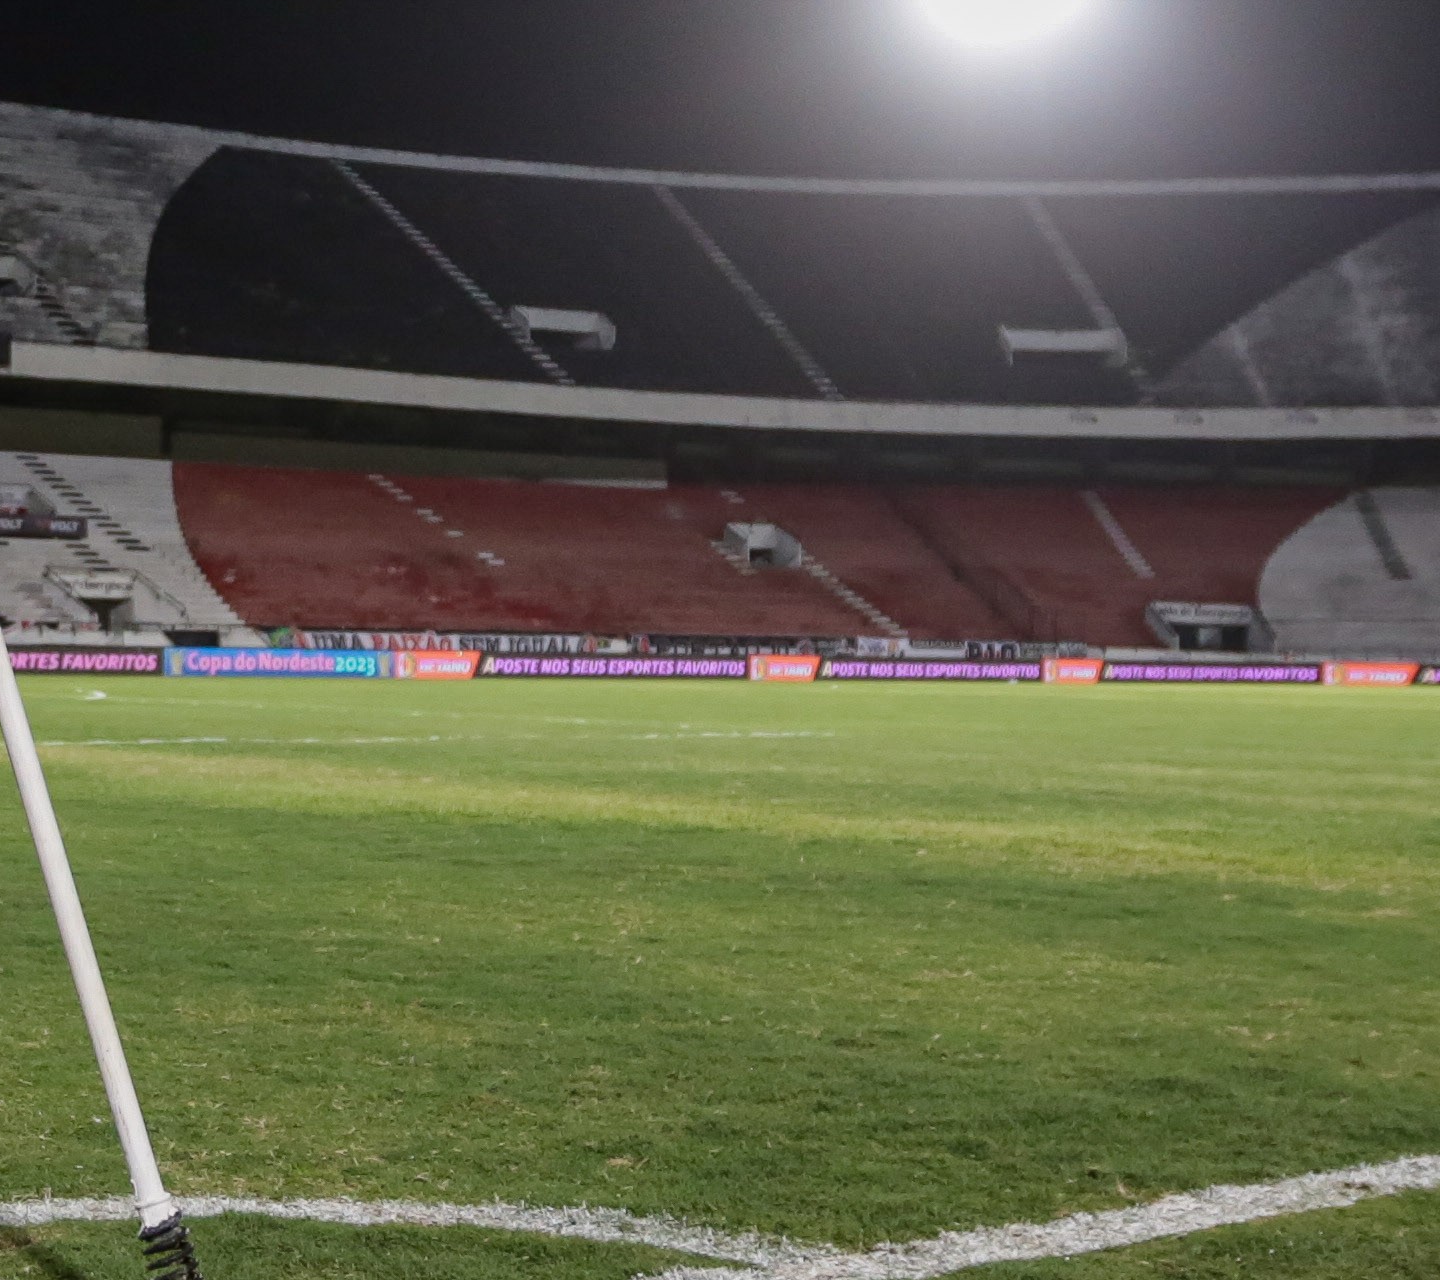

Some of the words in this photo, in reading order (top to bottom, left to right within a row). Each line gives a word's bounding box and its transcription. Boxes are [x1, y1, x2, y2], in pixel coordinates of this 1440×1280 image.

[62, 651, 157, 671] FAVORITOS
[187, 652, 231, 676] Copa
[235, 652, 258, 672] do
[259, 653, 334, 675] Nordeste
[334, 656, 376, 677] 2023
[483, 657, 538, 677] APOSTE
[540, 659, 570, 677] NOS
[572, 660, 606, 677] SEUS
[608, 660, 674, 678] ESPORTES
[676, 660, 746, 678] FAVORITOS
